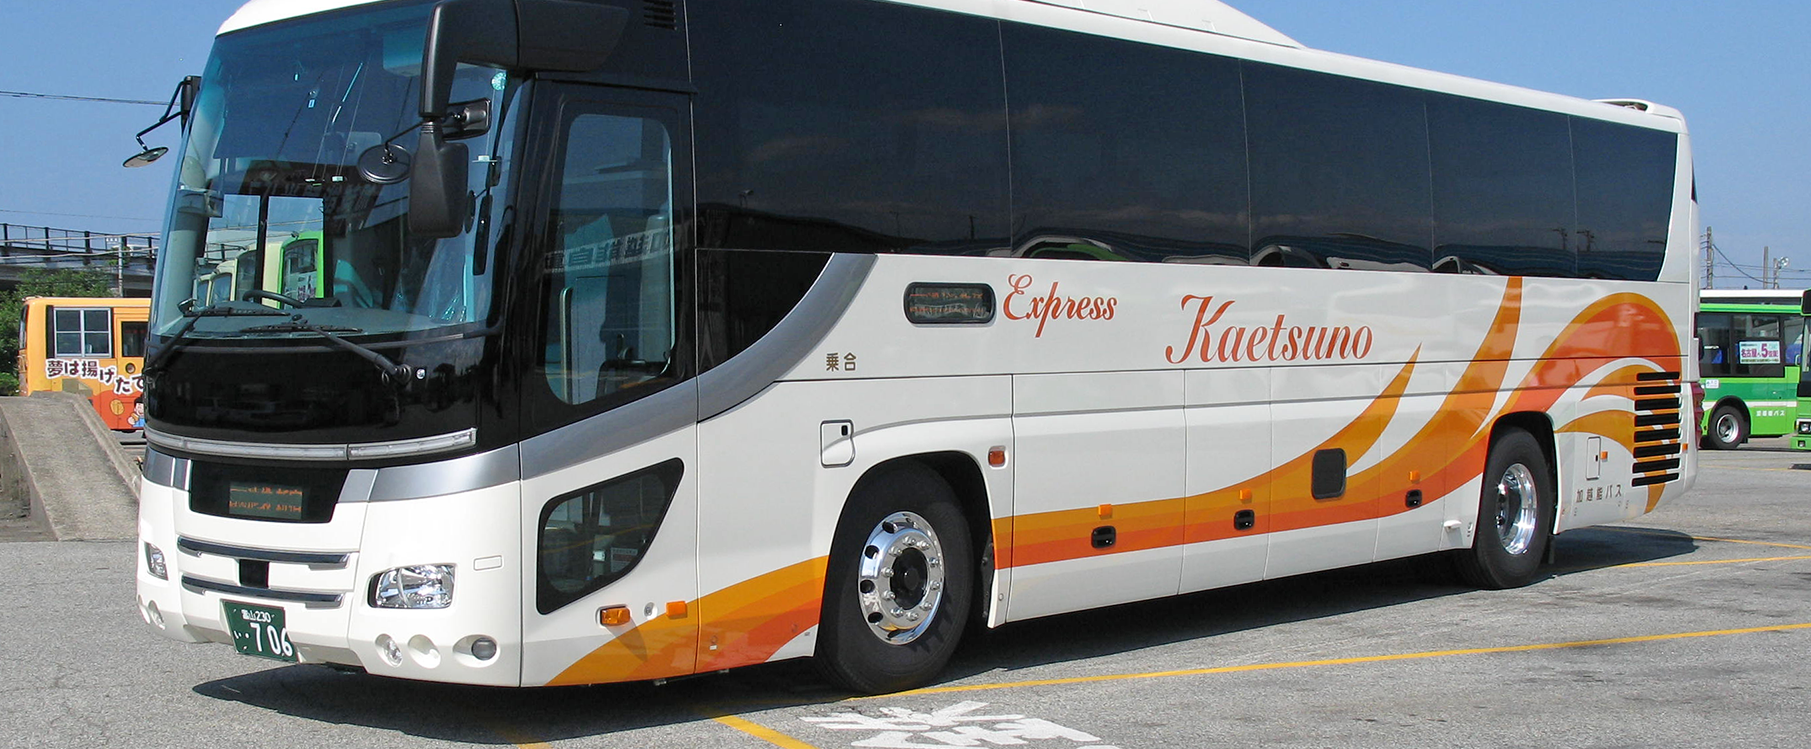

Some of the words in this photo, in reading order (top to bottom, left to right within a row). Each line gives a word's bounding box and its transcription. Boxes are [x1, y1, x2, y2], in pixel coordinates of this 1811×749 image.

[1003, 274, 1118, 338] Express
[1165, 294, 1373, 364] Kaetsuno
[826, 352, 857, 371] 乗合
